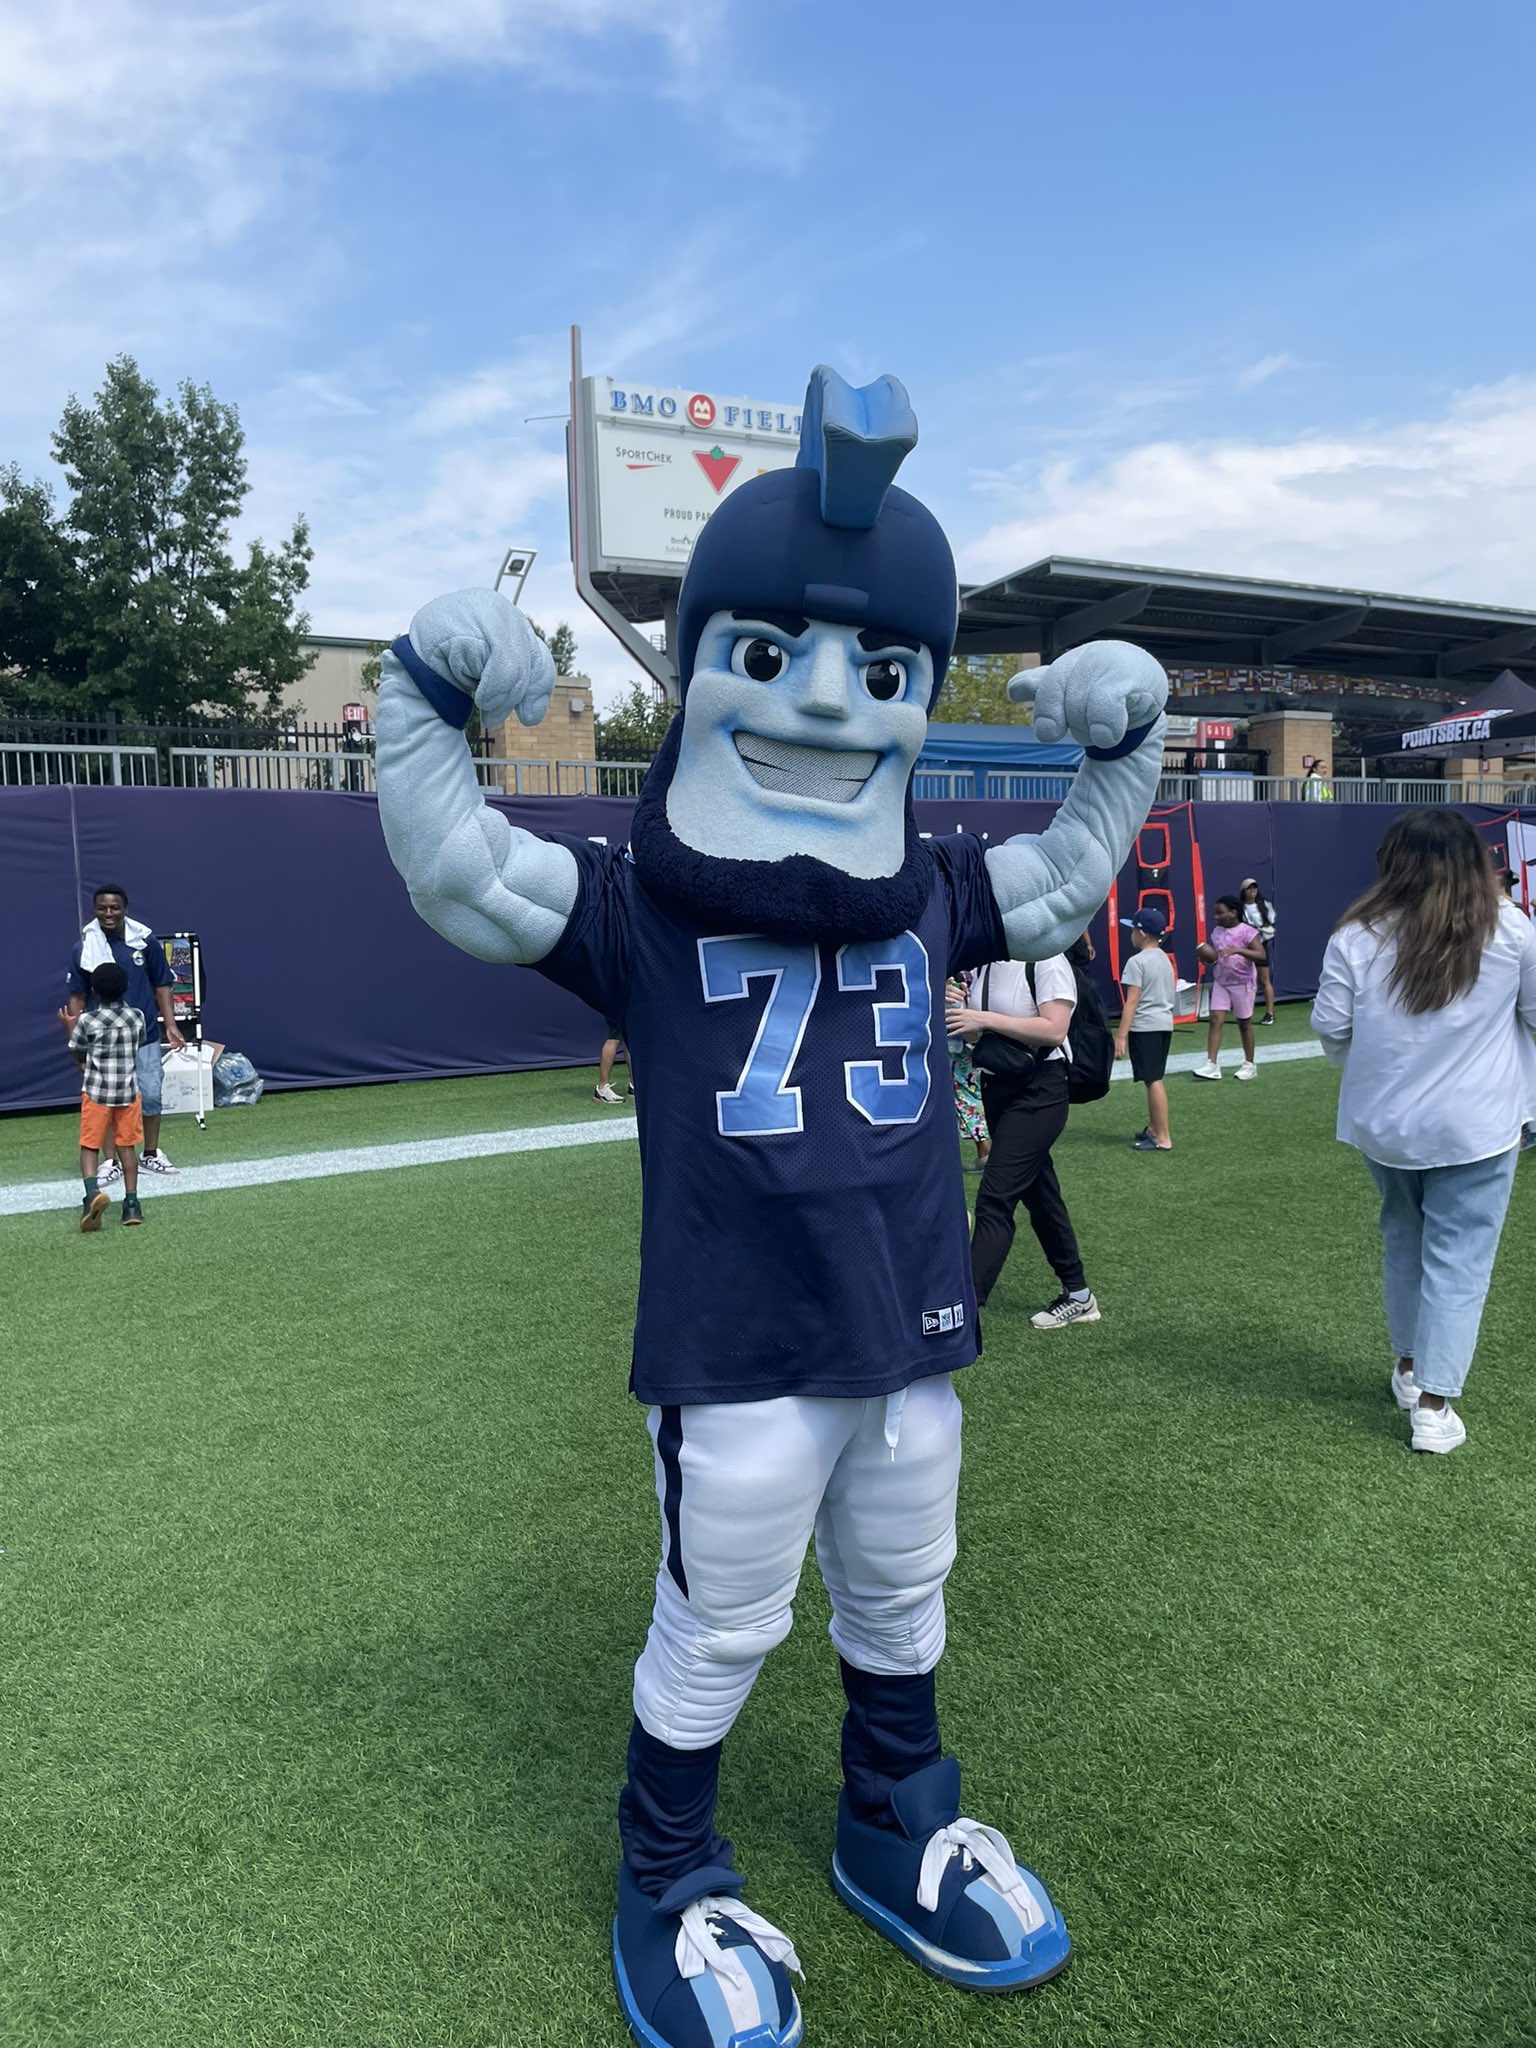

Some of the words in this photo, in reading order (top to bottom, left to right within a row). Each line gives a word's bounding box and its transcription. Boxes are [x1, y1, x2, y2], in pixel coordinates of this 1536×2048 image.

[611, 390, 677, 417] BMO
[664, 508, 693, 520] PROUD
[1206, 724, 1231, 737] GATE
[1401, 719, 1491, 750] POINTSBET.CA
[697, 930, 931, 1136] 73
